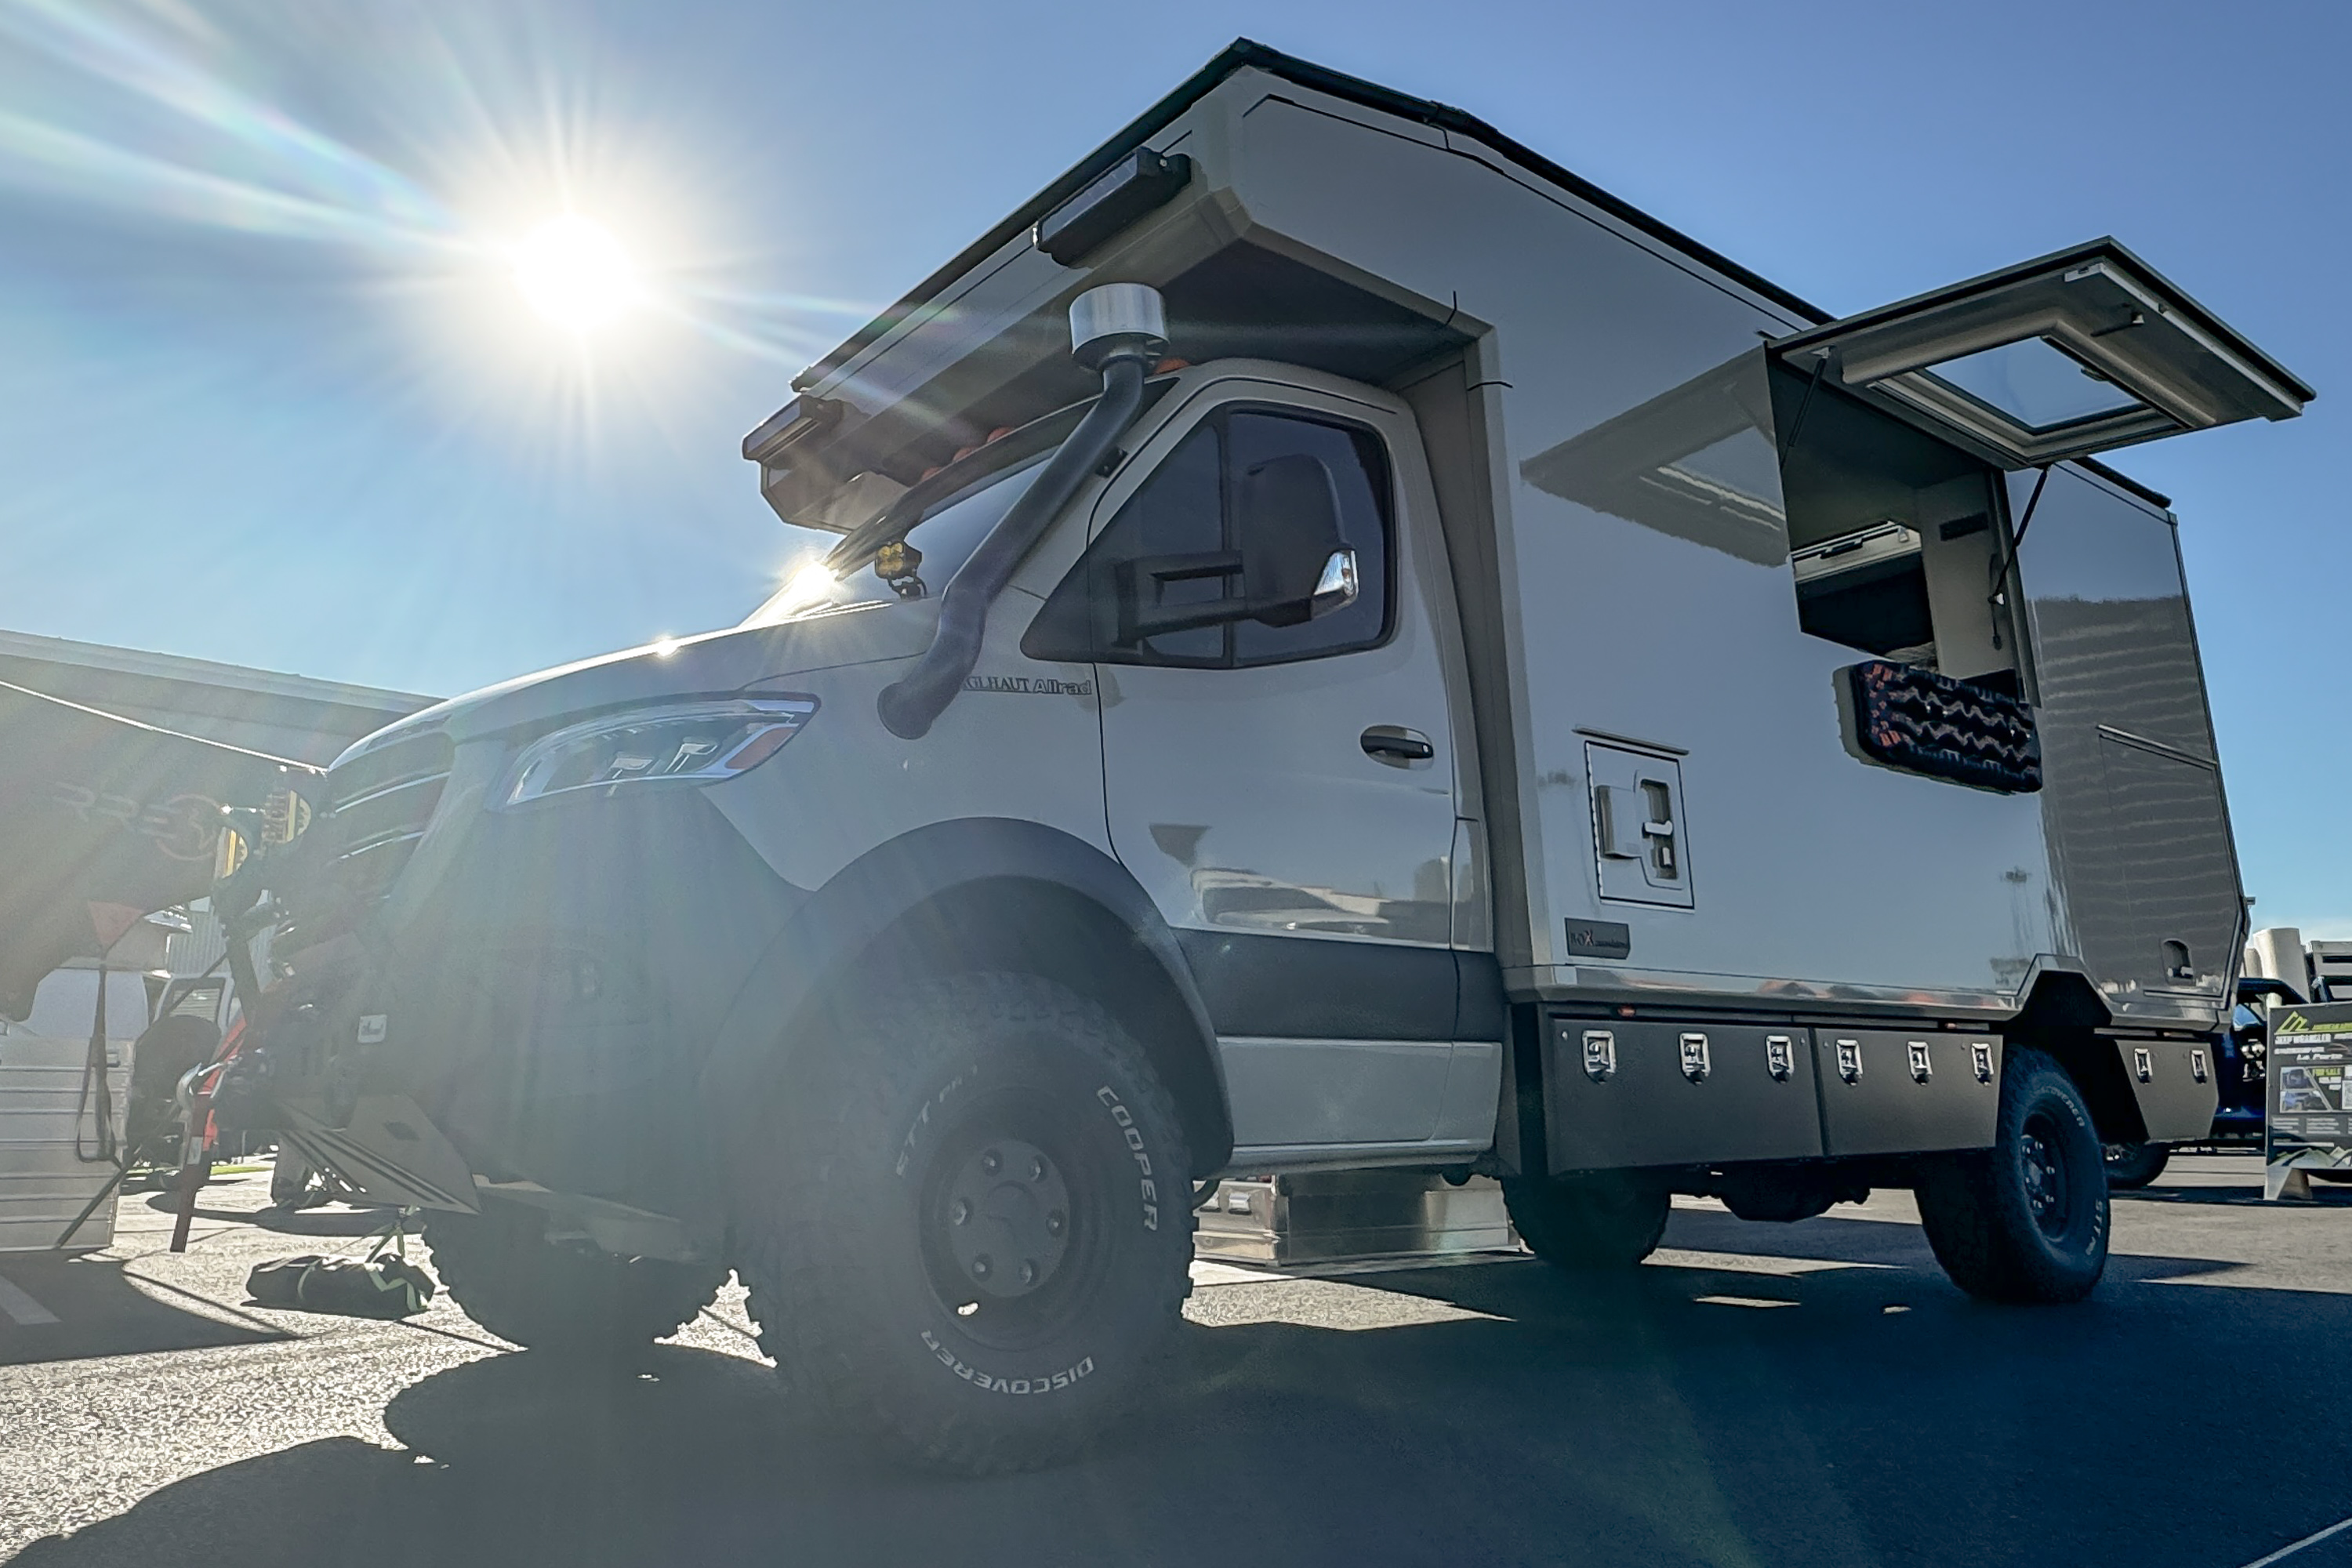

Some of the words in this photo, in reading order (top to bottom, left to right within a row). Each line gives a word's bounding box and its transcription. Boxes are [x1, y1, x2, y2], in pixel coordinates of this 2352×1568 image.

[1033, 678, 1092, 695] Allrad
[1096, 1085, 1157, 1232] COOPER
[920, 1329, 1095, 1396] DISCOVERER
